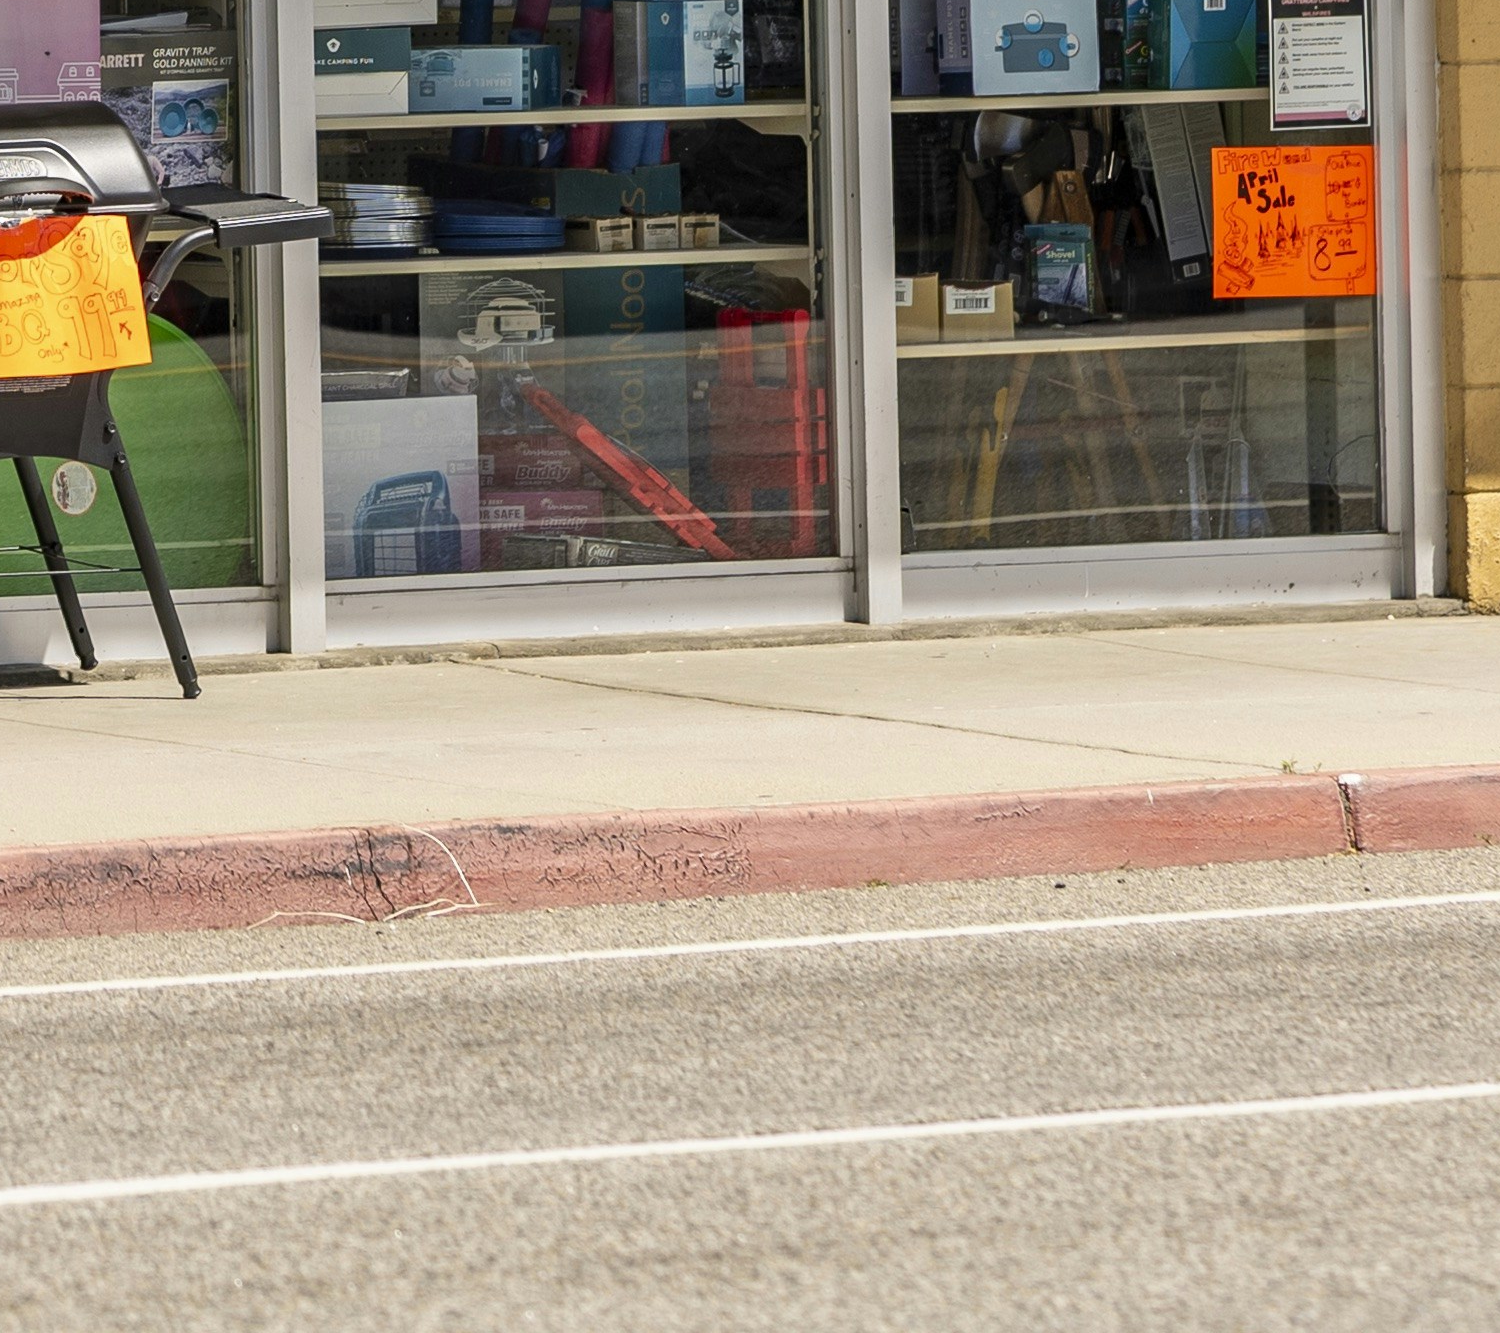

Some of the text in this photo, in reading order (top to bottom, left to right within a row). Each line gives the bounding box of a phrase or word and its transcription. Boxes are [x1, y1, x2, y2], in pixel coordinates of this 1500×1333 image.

[152, 48, 190, 58] GRAVITY
[152, 56, 233, 69] GOLD PANNING KIT
[359, 57, 374, 65] FUN
[1256, 185, 1296, 214] Sale
[1045, 249, 1076, 259] Shovel
[514, 464, 572, 482] Buddy
[493, 508, 521, 519] SAFE
